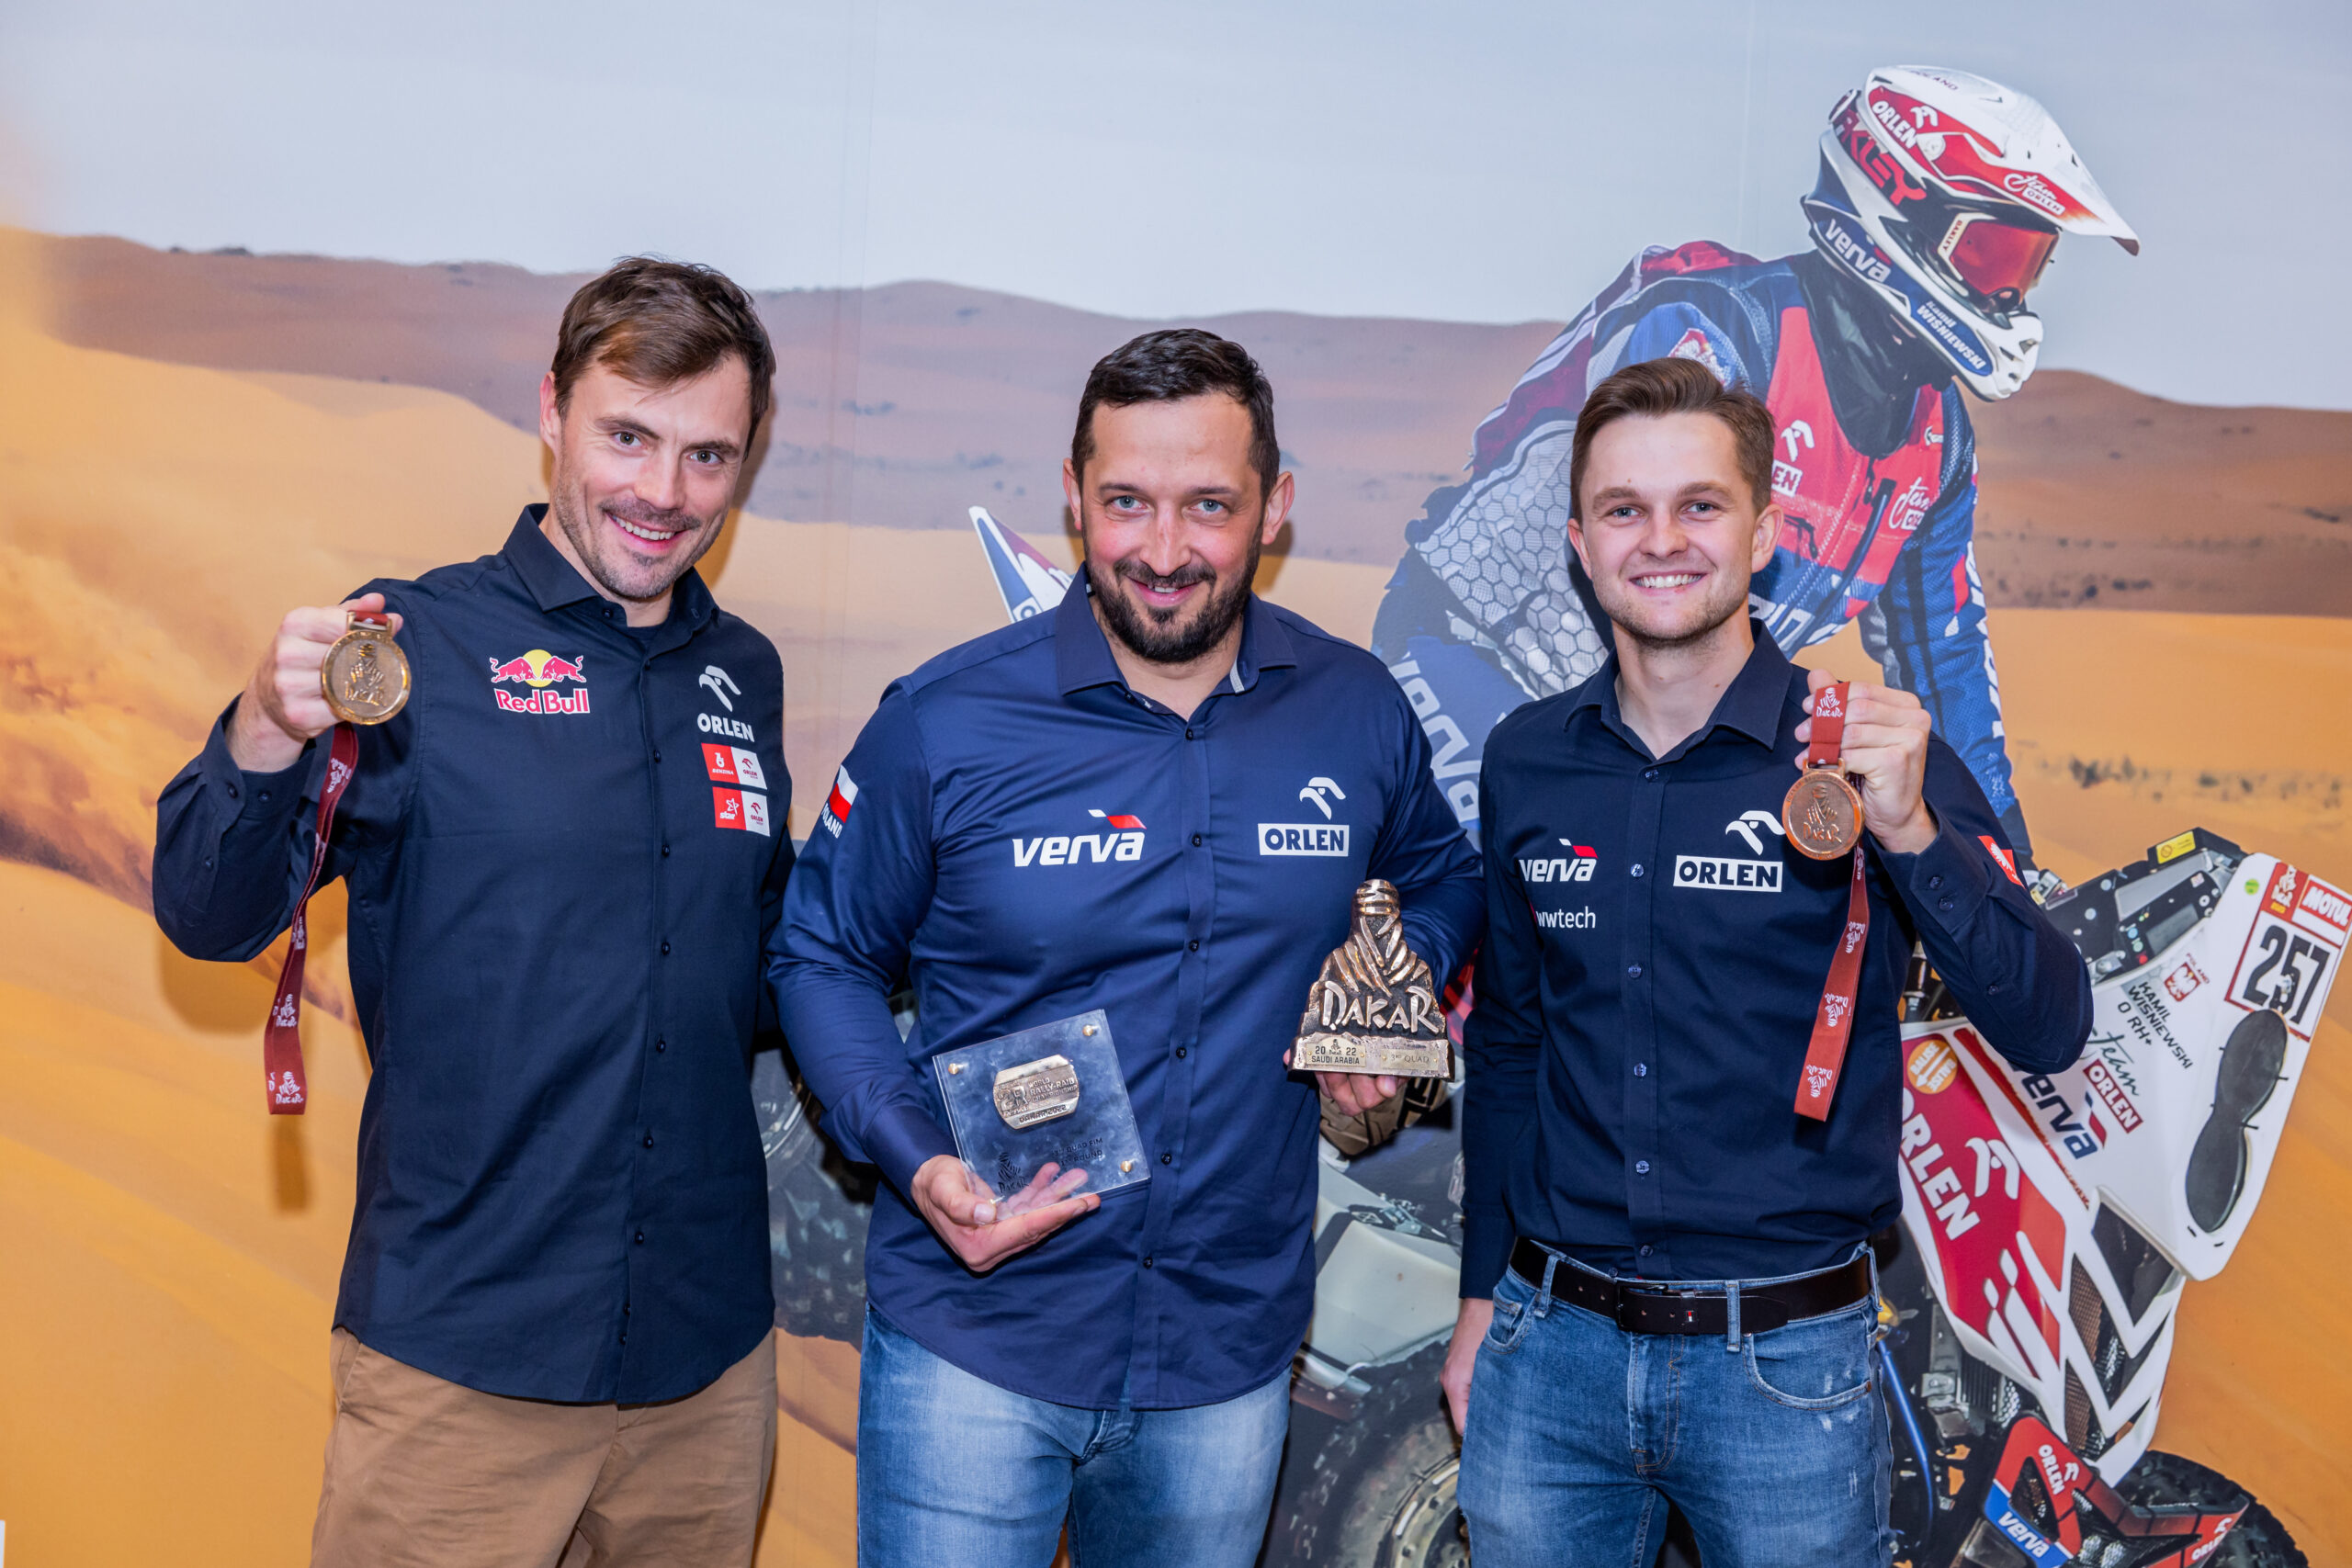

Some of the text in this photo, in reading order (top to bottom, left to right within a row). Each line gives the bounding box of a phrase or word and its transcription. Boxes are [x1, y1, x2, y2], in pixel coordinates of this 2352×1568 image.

[1872, 101, 1917, 149] ORLEN
[2026, 189, 2061, 212] ORLEN
[1825, 219, 1892, 282] verva
[494, 688, 590, 714] Red Bull
[697, 713, 754, 742] ORLEN
[1012, 830, 1146, 867] verva
[1264, 829, 1344, 851] ORLEN
[1519, 859, 1597, 882] verva
[1679, 861, 1778, 887] ORLEN
[2243, 924, 2330, 1024] 257
[1323, 980, 1439, 1034] DAKAR
[2139, 981, 2171, 1022] KAMIL
[2128, 986, 2194, 1069] WISNIEWSKI
[1311, 1055, 1332, 1064] SAUDI
[1315, 1045, 1357, 1055] 20 22
[1404, 1055, 1430, 1064] QUAD
[2008, 1063, 2098, 1159] erva
[2087, 1064, 2139, 1130] ORLEN
[2038, 1444, 2065, 1495] ORLEN
[1998, 1511, 2050, 1558] verva
